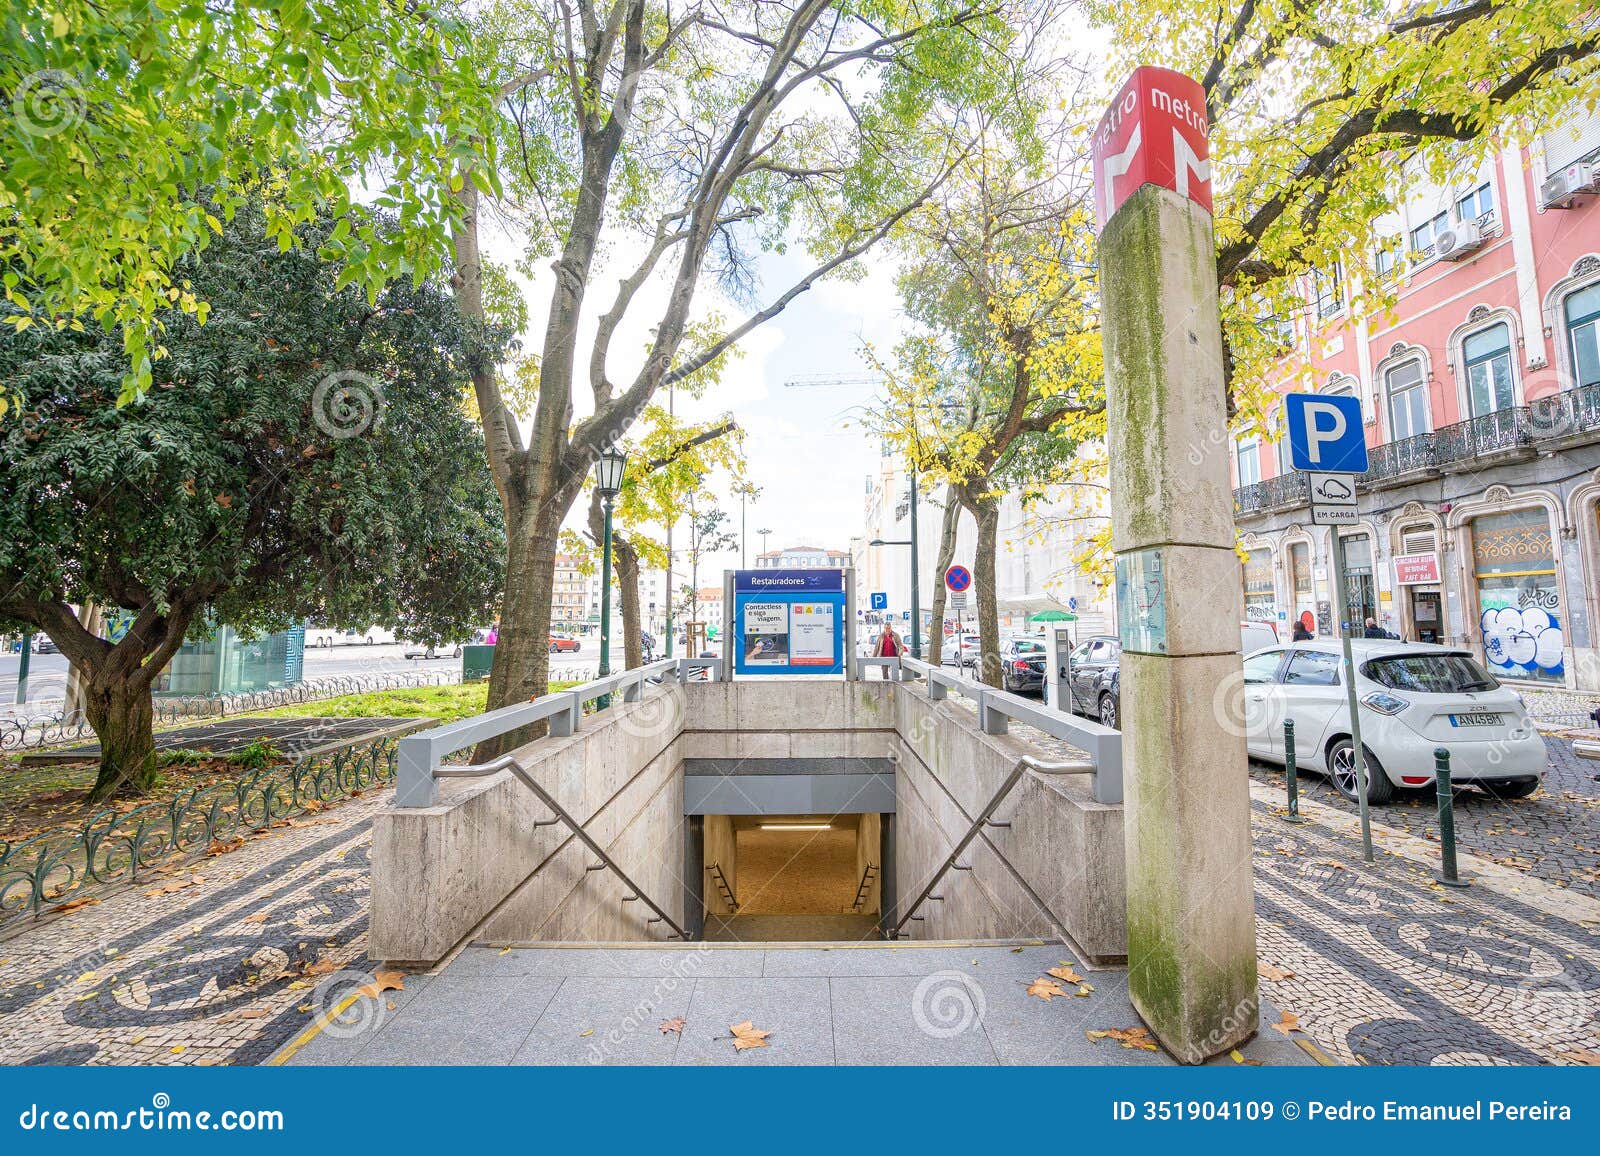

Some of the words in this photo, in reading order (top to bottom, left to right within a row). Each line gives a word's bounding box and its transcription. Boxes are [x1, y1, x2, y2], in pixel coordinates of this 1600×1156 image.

[1151, 88, 1208, 139] metro
[1303, 401, 1347, 463] P
[751, 577, 805, 585] Restauradores
[874, 594, 884, 608] P
